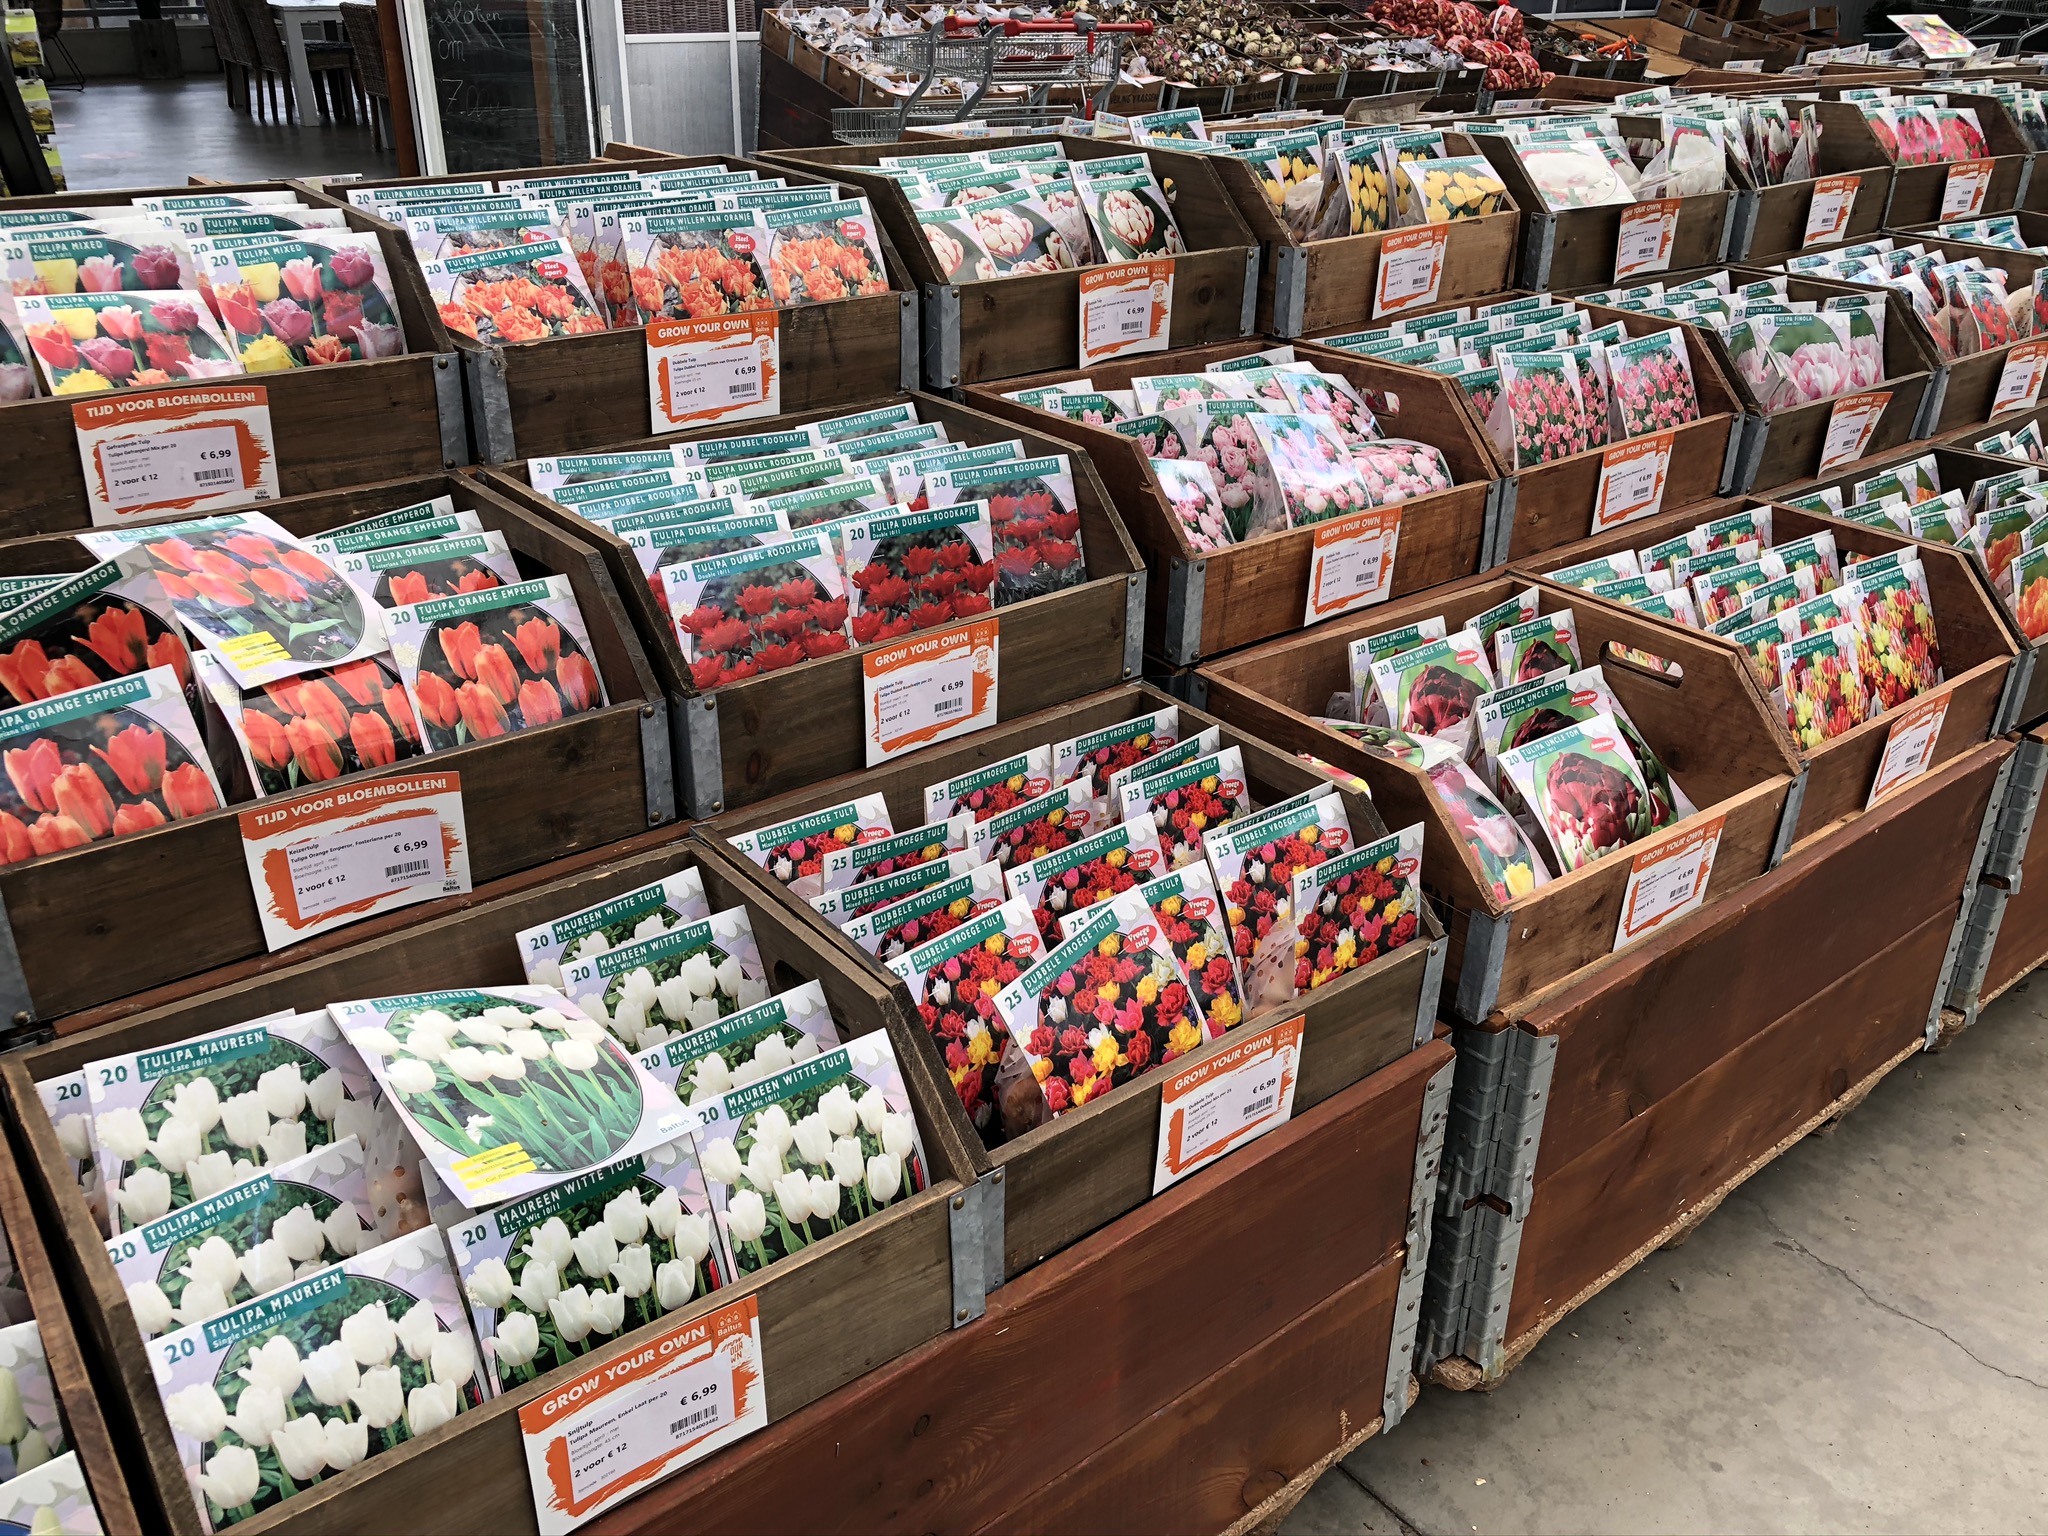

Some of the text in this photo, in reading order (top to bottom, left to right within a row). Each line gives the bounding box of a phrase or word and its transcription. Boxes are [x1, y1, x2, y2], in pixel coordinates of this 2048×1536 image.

[210, 244, 302, 266] 20 TULIPA MIXED
[425, 242, 558, 275] 20 TULIPA WILLEM VAN ORANJE
[544, 269, 562, 277] apart
[1085, 266, 1148, 285] GROW YOUR OWN
[658, 319, 749, 338] GROW YOUR OWN
[741, 366, 756, 375] 6,99
[86, 392, 256, 417] TIJD VOOR BLOEMBOLLEN!
[201, 449, 231, 460] € 6,99
[122, 477, 139, 486] voor
[1321, 516, 1380, 539] GROW YOUR OWN
[670, 540, 817, 583] 20 TULIPA DUBBEL ROODKAPJE
[391, 582, 545, 624] 20 TULIPA ORANGE EMPEROR
[875, 632, 968, 667] GROW YOUR OWN
[948, 680, 964, 691] 6,99
[27, 680, 144, 720] ORANGE EMPEROR
[1485, 682, 1565, 721] 20 TULIPA UNCLE TOM
[255, 779, 447, 826] TIJD VOOR BLOEMBOLLEN!
[291, 854, 307, 864] Tulipa
[309, 850, 328, 860] Orange
[330, 844, 354, 855] Emperor,
[355, 835, 383, 846] Fosteriana
[394, 840, 428, 854] € 6,99
[1640, 828, 1704, 864] GROW YOUR OWN
[298, 887, 303, 895] 2
[305, 882, 326, 893] voor
[336, 875, 346, 883] 12
[1127, 928, 1152, 944] Vroege
[1134, 937, 1150, 950] tulp
[1004, 913, 1113, 1011] 25 DUBBELE VROEGE TULP
[100, 1030, 265, 1086] 20 TULIPA MAUREEN
[1174, 1034, 1272, 1091] GROW YOUR OWN
[698, 1051, 846, 1124] 20 MAUREEN WITTE TULP
[1253, 1078, 1276, 1094] € 6,99
[658, 1117, 691, 1135] Baltus
[164, 1272, 342, 1364] 20 TULIPA MAUREEN
[212, 1311, 287, 1349] Single Late 10/11
[718, 1321, 742, 1337] Baltus
[542, 1324, 706, 1416] GROW YOUR OWN
[680, 1383, 718, 1406] € 6,99
[567, 1420, 593, 1437] Snijtulp
[570, 1433, 588, 1446] Tulipa
[589, 1417, 617, 1436] Maureen,
[618, 1406, 634, 1419] Enkel
[634, 1400, 647, 1410] Laat
[648, 1394, 658, 1404] per
[575, 1442, 627, 1478] 2 voor € 12
